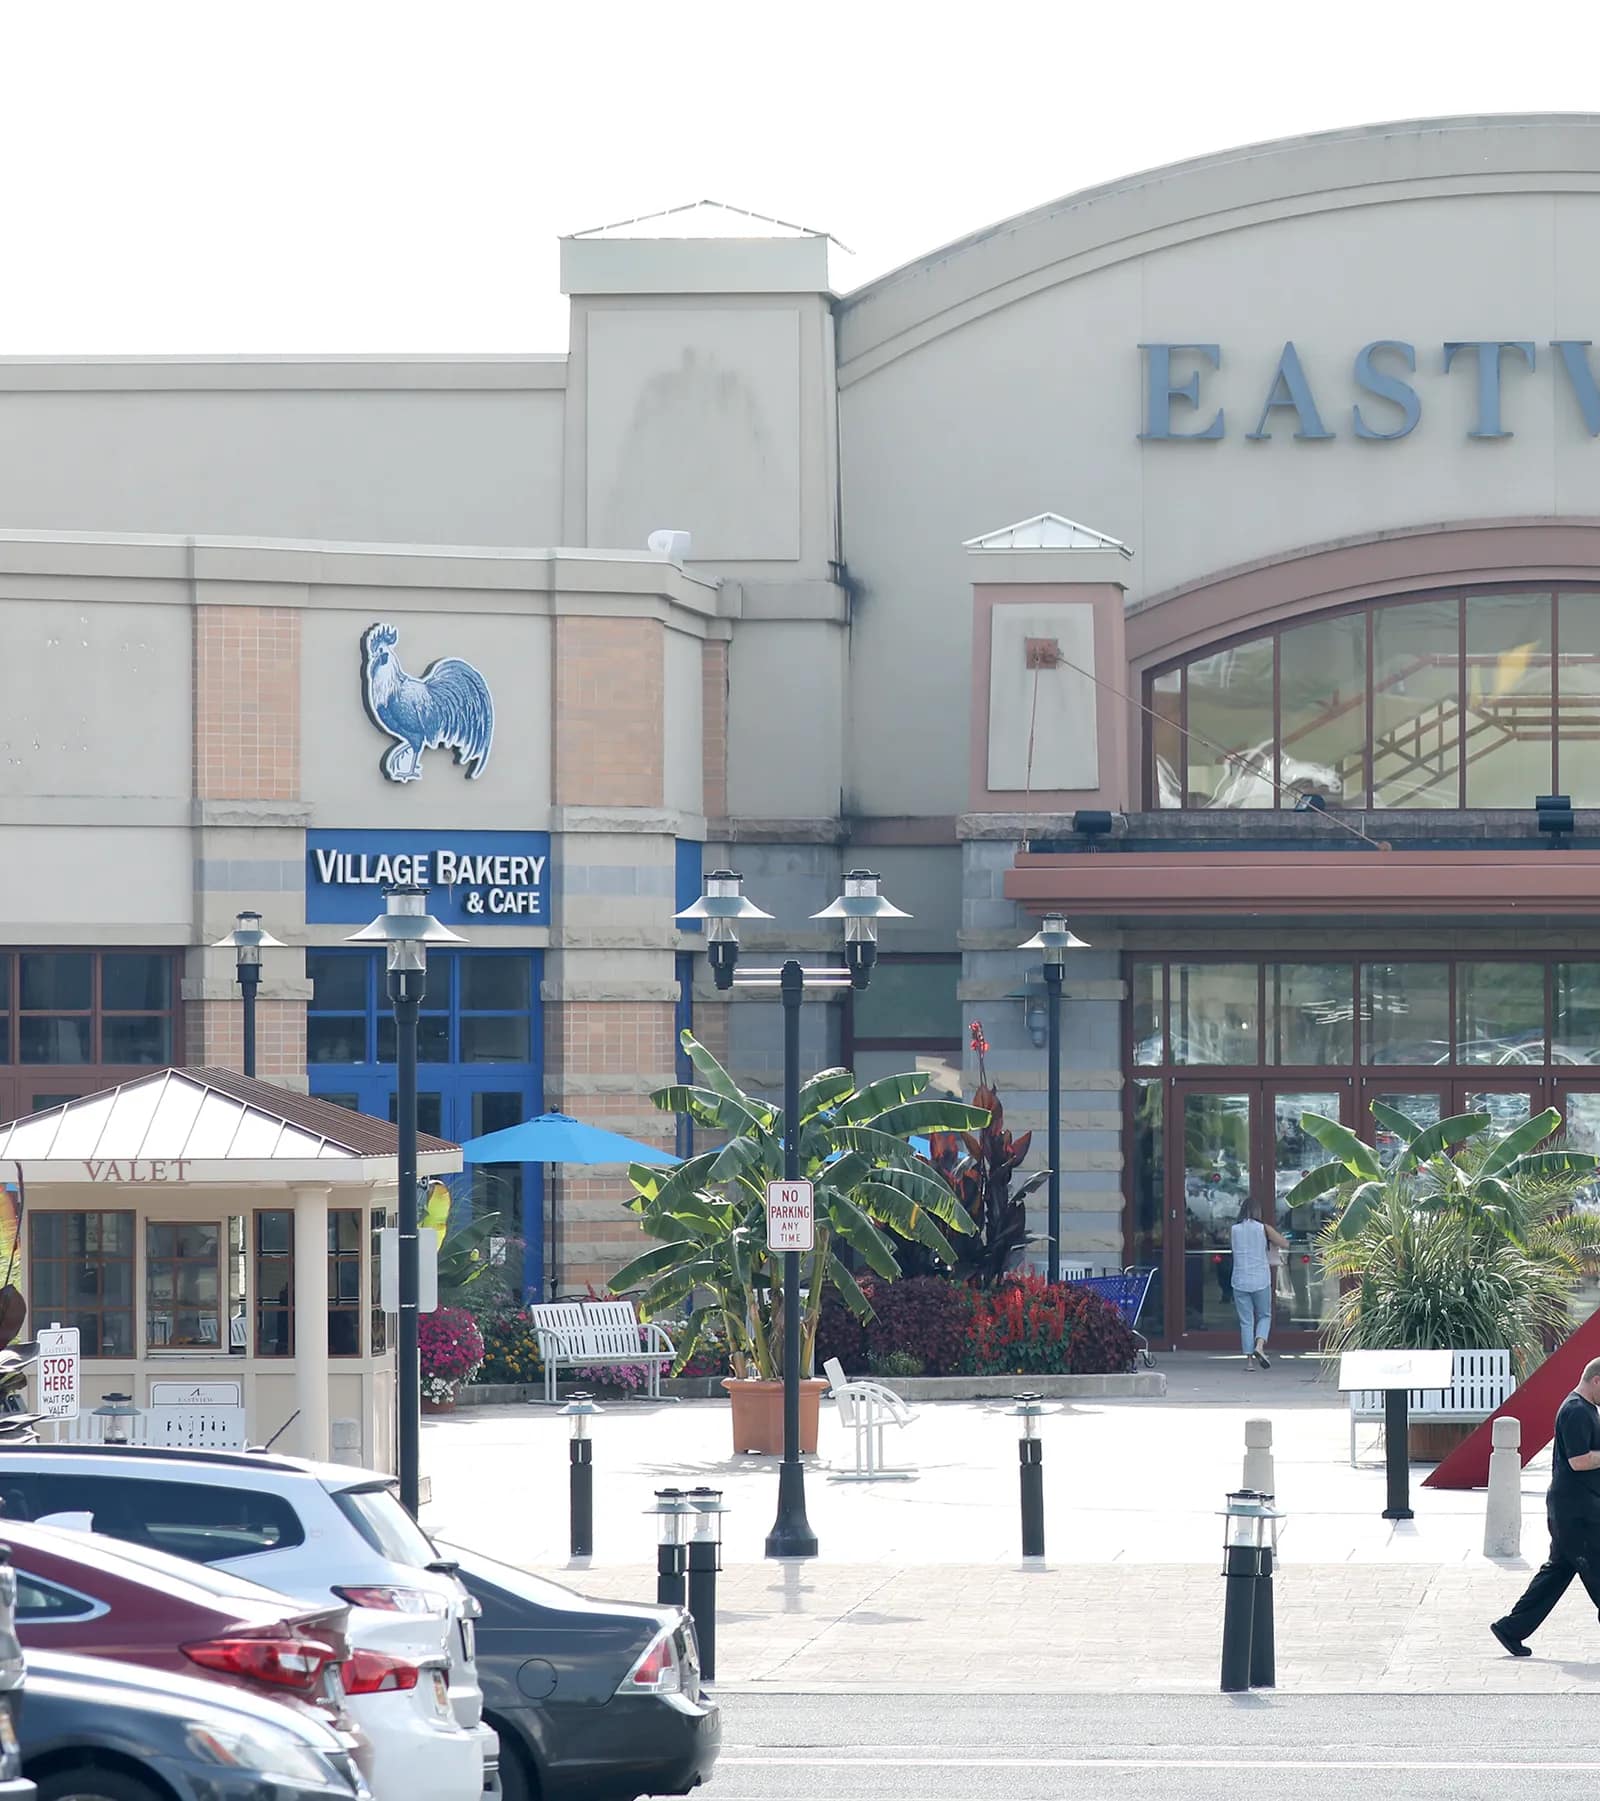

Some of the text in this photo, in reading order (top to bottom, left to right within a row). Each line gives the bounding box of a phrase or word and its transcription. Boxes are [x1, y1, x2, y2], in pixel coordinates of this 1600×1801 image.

[316, 848, 546, 886] VILLAGE BAKERY
[466, 887, 541, 915] & CAFE
[82, 1159, 192, 1182] VALET
[782, 1189, 799, 1203] NO
[771, 1205, 810, 1219] PARKING
[781, 1221, 799, 1231] ANY
[780, 1233, 801, 1243] TIME
[43, 1358, 74, 1375] STOP
[43, 1375, 74, 1391] HERE
[42, 1393, 75, 1404] WAIT FOR
[48, 1404, 69, 1415] VALET
